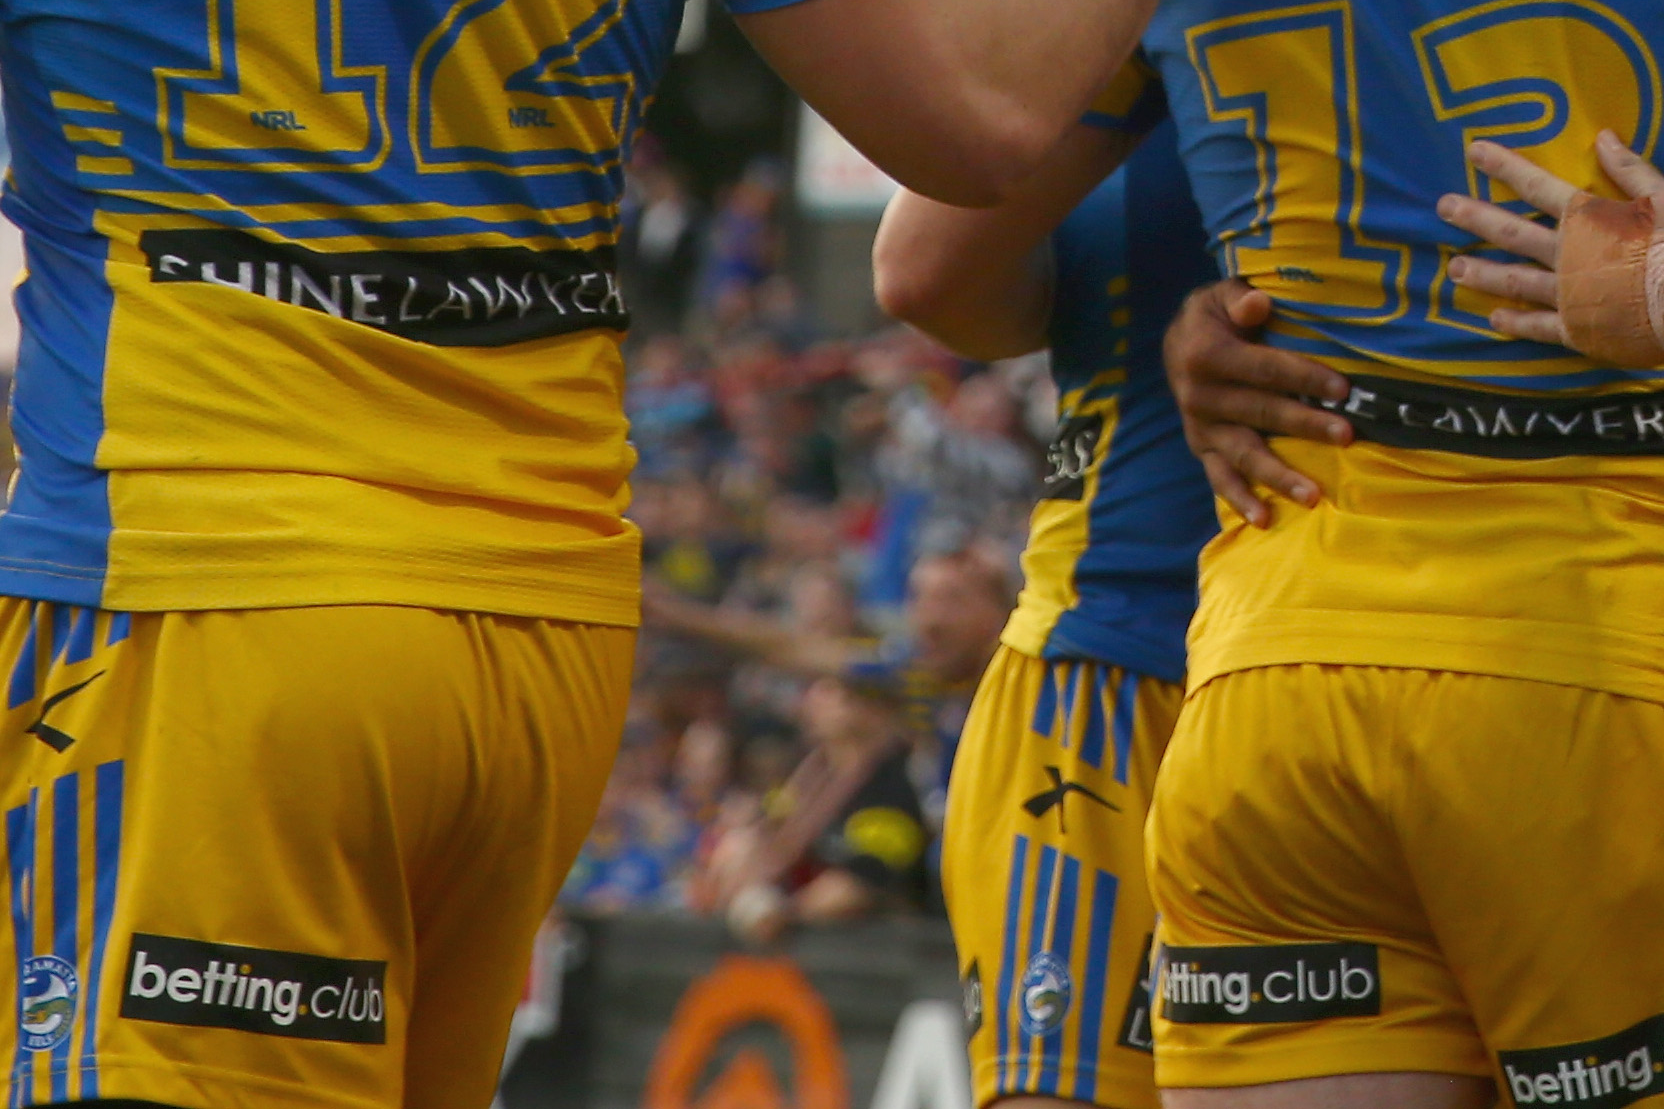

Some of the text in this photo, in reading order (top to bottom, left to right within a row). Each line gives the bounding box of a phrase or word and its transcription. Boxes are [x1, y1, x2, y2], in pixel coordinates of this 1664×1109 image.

[250, 109, 306, 131] NRL
[507, 106, 556, 129] NRL
[129, 950, 384, 1027] betting.club
[1162, 957, 1375, 1016] tting.club
